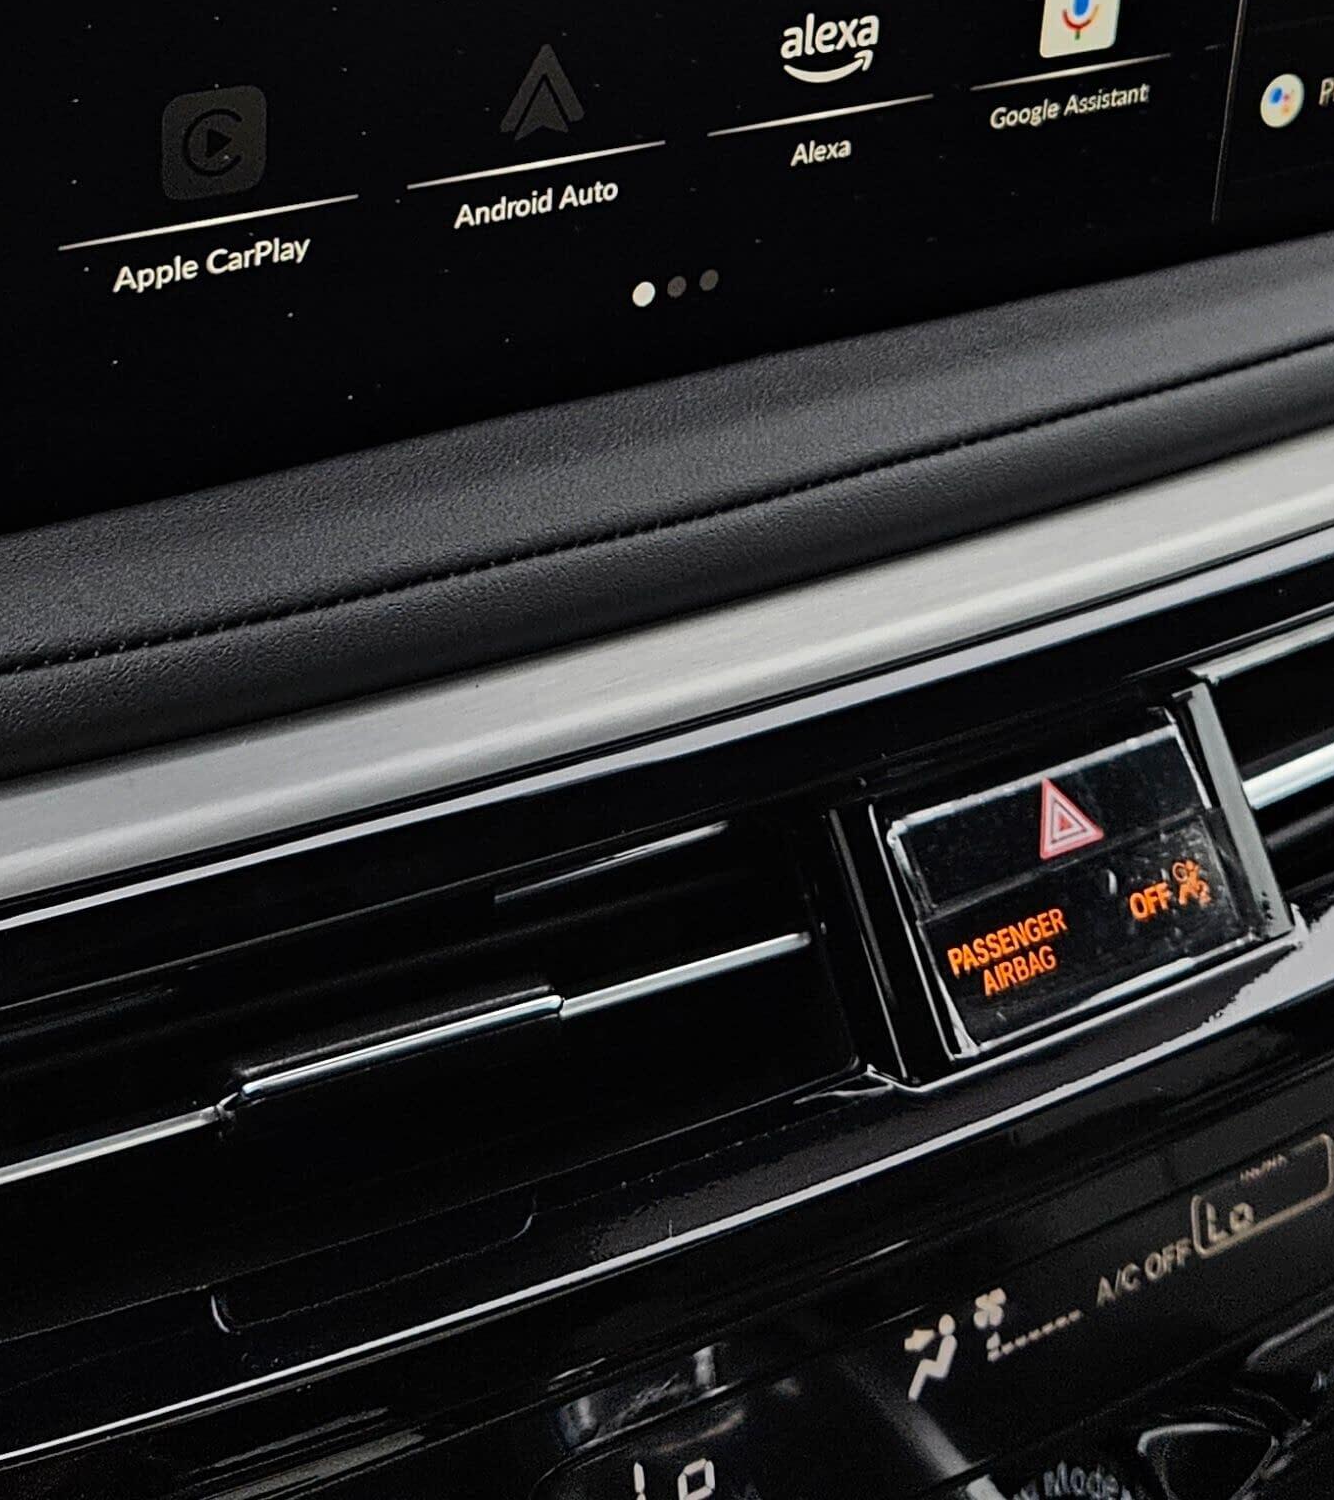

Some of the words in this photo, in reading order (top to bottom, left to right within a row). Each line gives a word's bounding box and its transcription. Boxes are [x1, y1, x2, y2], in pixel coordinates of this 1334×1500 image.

[780, 12, 880, 59] alexa
[989, 98, 1061, 130] Google
[1063, 83, 1150, 117] Assistant
[790, 139, 852, 167] Alexa
[453, 193, 553, 230] Android
[558, 181, 619, 210] Auto
[112, 255, 199, 294] Apple
[206, 237, 311, 275] CarPlay
[1128, 882, 1173, 920] OFF
[947, 908, 1067, 977] PASSENGER
[982, 946, 1057, 997] AIRBAG
[1097, 1263, 1141, 1306] A/C
[1144, 1238, 1191, 1281] OFF
